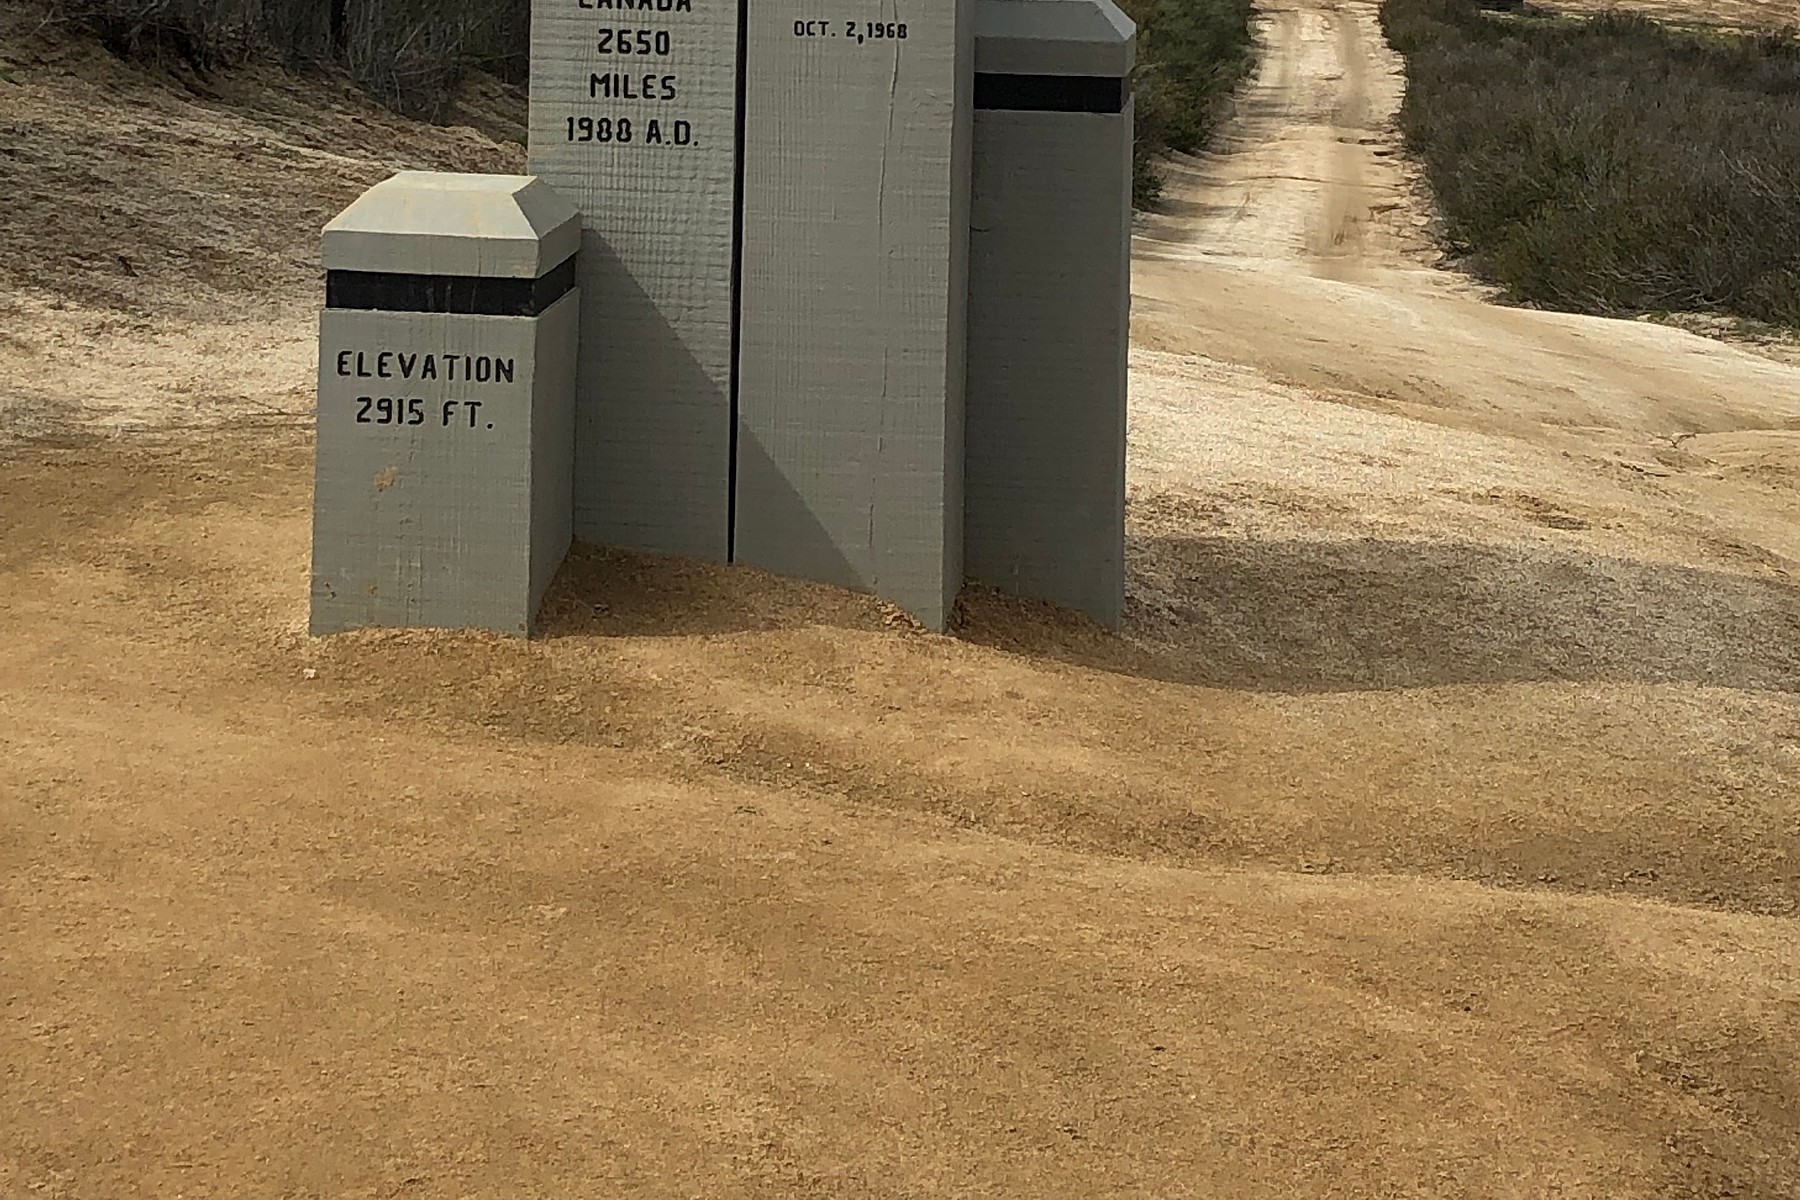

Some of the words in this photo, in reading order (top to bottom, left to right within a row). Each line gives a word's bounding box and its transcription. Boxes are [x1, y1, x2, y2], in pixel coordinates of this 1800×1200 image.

[597, 29, 670, 56] 2650
[794, 21, 836, 37] OCT.
[590, 73, 677, 101] MILES
[566, 116, 632, 143] 1988
[646, 120, 699, 147] A.D.
[337, 351, 514, 383] ELEVATION
[356, 397, 424, 425] 2915
[442, 401, 493, 429] FT.
